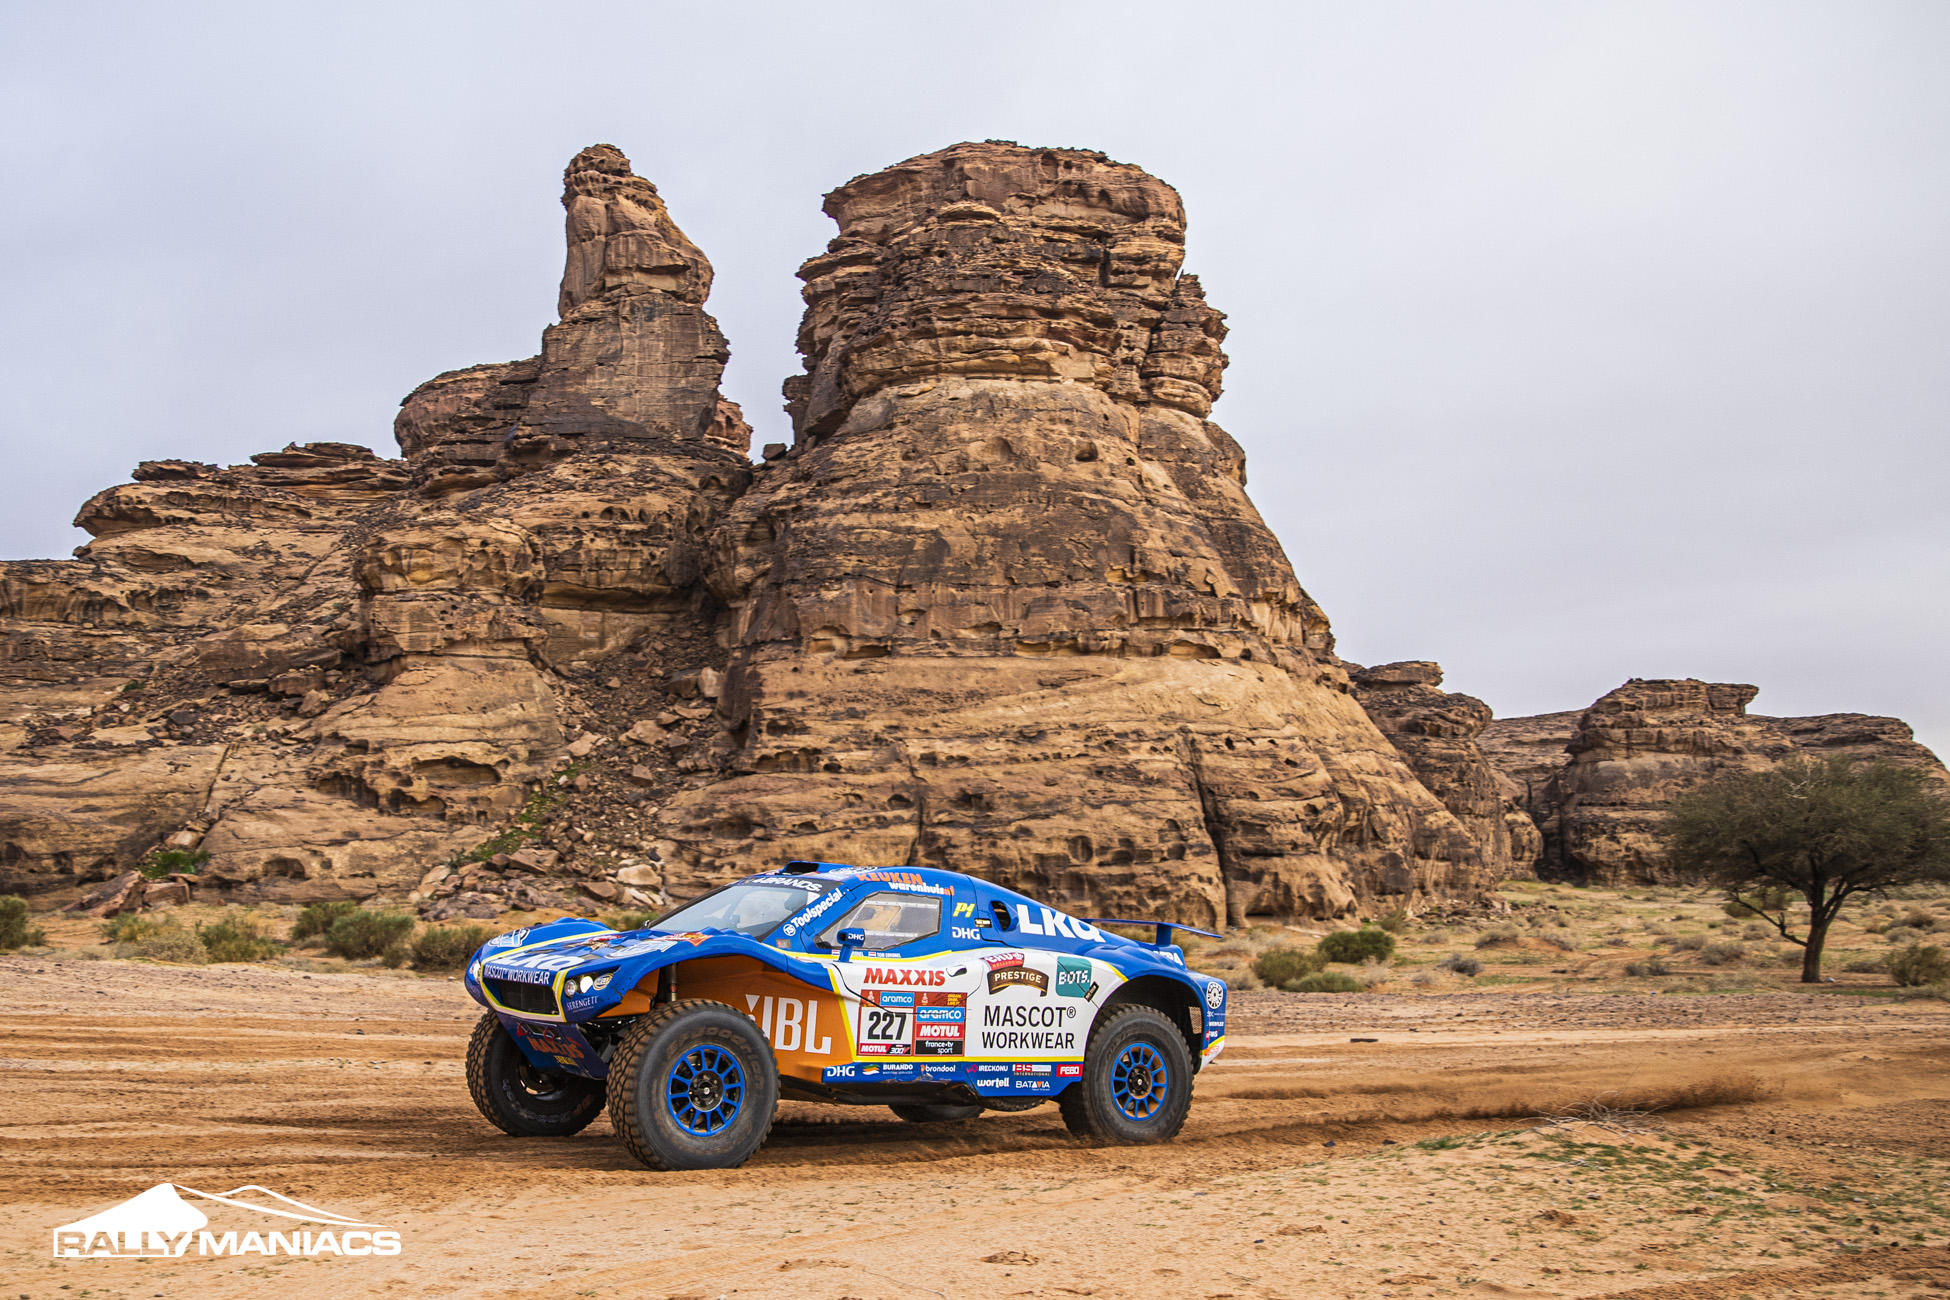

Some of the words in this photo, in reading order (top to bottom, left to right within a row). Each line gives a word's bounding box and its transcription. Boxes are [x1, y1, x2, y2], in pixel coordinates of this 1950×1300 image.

[856, 872, 923, 885] KEUKEN
[790, 888, 843, 928] Toolspecial
[1016, 903, 1106, 943] LKQ
[848, 933, 865, 941] DHG
[952, 927, 980, 940] DHG
[507, 968, 550, 985] WORKWEAR
[863, 968, 946, 986] MAXXIS
[994, 971, 1043, 983] PRESTIGE
[882, 995, 913, 1003] aramco
[919, 1009, 962, 1019] aramco
[867, 1011, 907, 1040] 227
[920, 1025, 960, 1036] MOTUL
[981, 1031, 1075, 1049] WORKWEAR
[861, 1045, 887, 1053] MOTUL
[937, 1047, 953, 1055] sport
[826, 1066, 855, 1077] DHG
[1015, 1063, 1033, 1073] BS
[1060, 1066, 1080, 1075] FEBO
[976, 1077, 1010, 1088] wortell
[1015, 1080, 1051, 1089] BATAVIA
